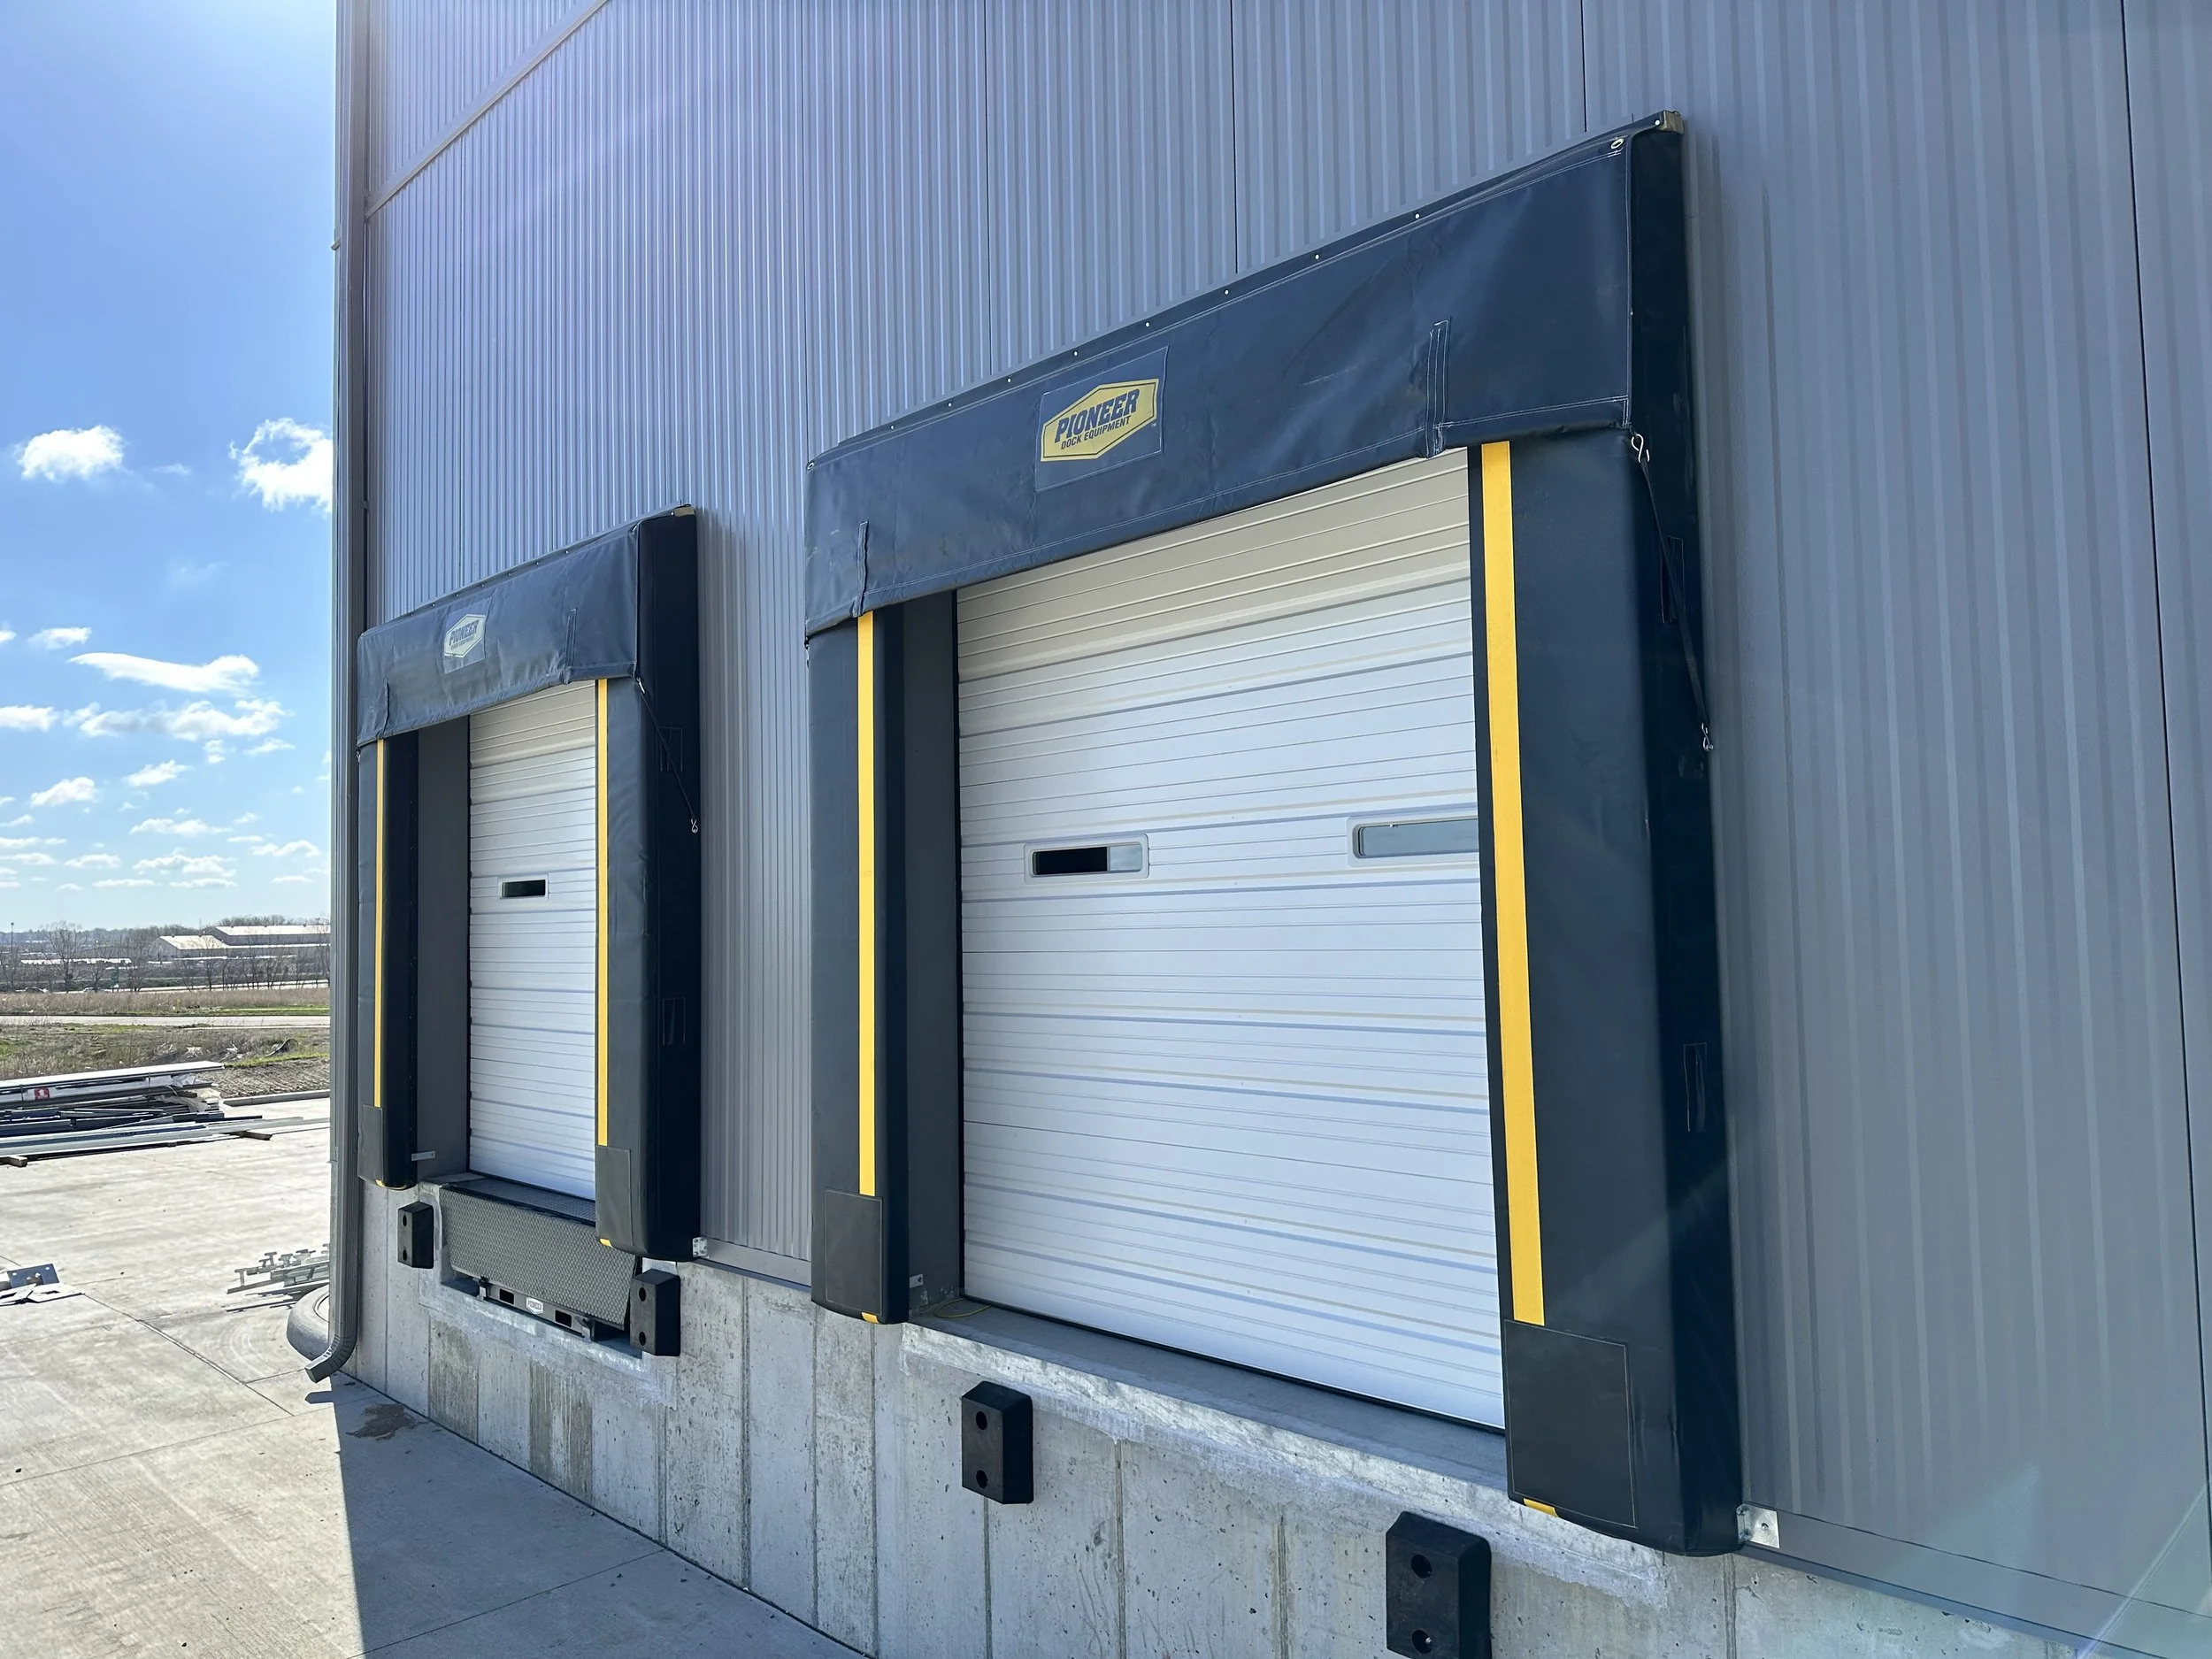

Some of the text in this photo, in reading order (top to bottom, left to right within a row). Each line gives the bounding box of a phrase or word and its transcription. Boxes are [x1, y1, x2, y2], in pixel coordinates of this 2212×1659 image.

[1055, 388, 1140, 443] PIONEER
[1061, 416, 1131, 449] DOCK EQUIPMENT
